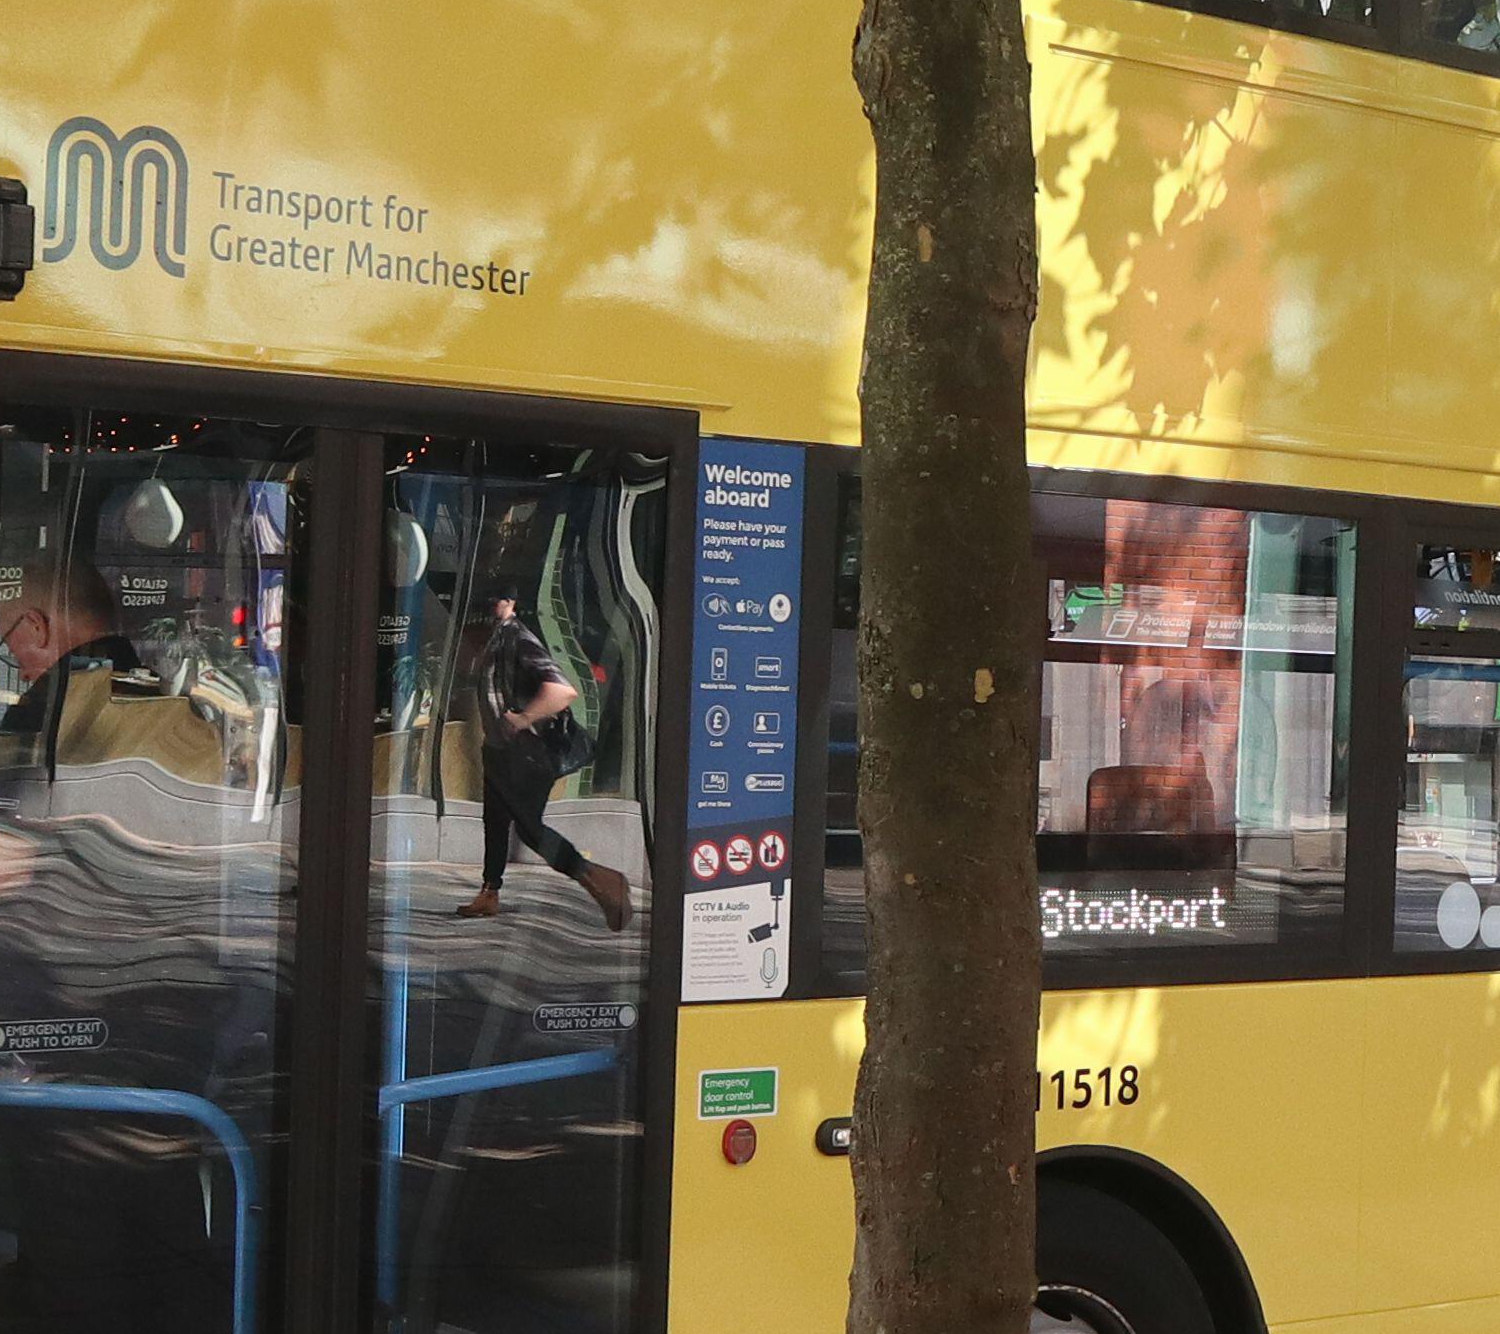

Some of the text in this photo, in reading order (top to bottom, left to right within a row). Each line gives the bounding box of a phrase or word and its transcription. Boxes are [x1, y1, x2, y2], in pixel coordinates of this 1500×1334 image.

[212, 170, 430, 234] Transport for
[209, 223, 531, 296] Greater Manchester
[704, 464, 792, 488] Welcome
[704, 486, 770, 508] aboard
[703, 518, 787, 535] Please have your
[703, 535, 785, 549] payment or pass
[702, 549, 734, 563] ready.
[746, 600, 764, 617] Pay
[692, 901, 750, 912] CCTV & Audio
[1041, 887, 1226, 937] Stockport
[692, 912, 743, 923] in operation
[540, 1006, 620, 1018] EMERGENCY EXIT
[5, 1022, 101, 1037] EMERGENCY EXIT
[547, 1017, 617, 1028] PUSH TO OPEN
[9, 1034, 93, 1048] PUSH TO OPEN
[705, 1077, 750, 1089] Emergency
[705, 1089, 754, 1103] door control
